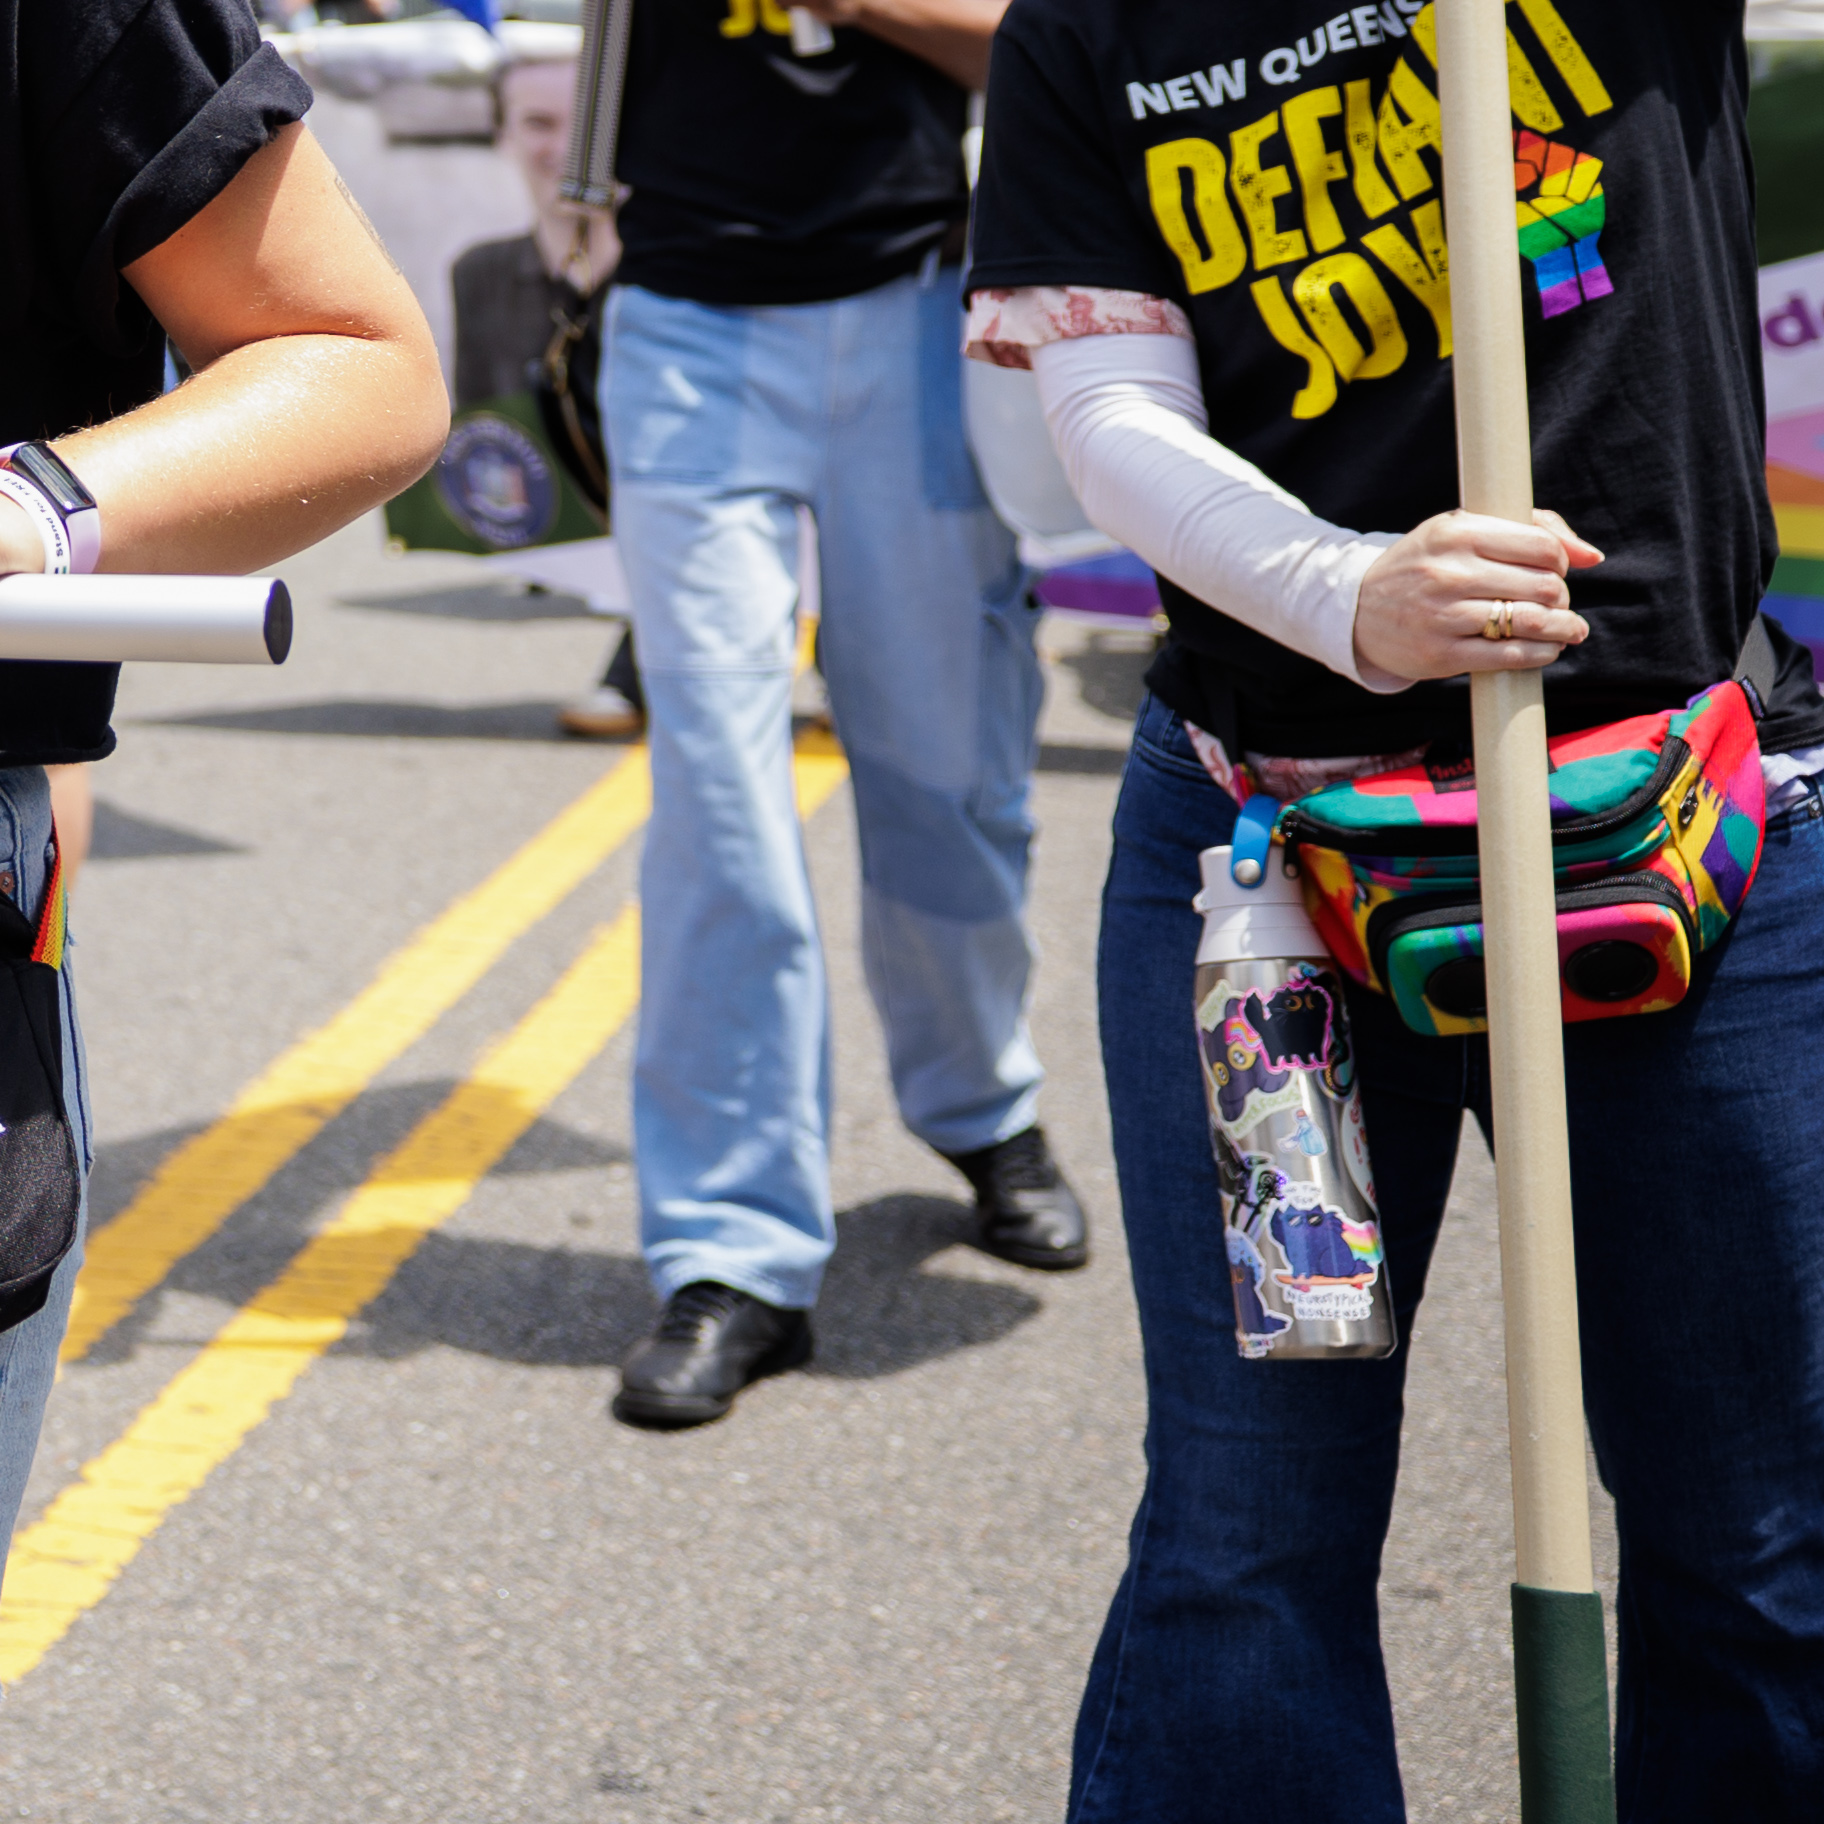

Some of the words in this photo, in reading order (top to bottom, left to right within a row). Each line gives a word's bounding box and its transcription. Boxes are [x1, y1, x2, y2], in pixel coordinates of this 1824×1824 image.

[1126, 58, 1247, 120] NEW
[1286, 1289, 1372, 1307] NEUROTYPICAL
[1297, 1307, 1369, 1318] NONSENSE
